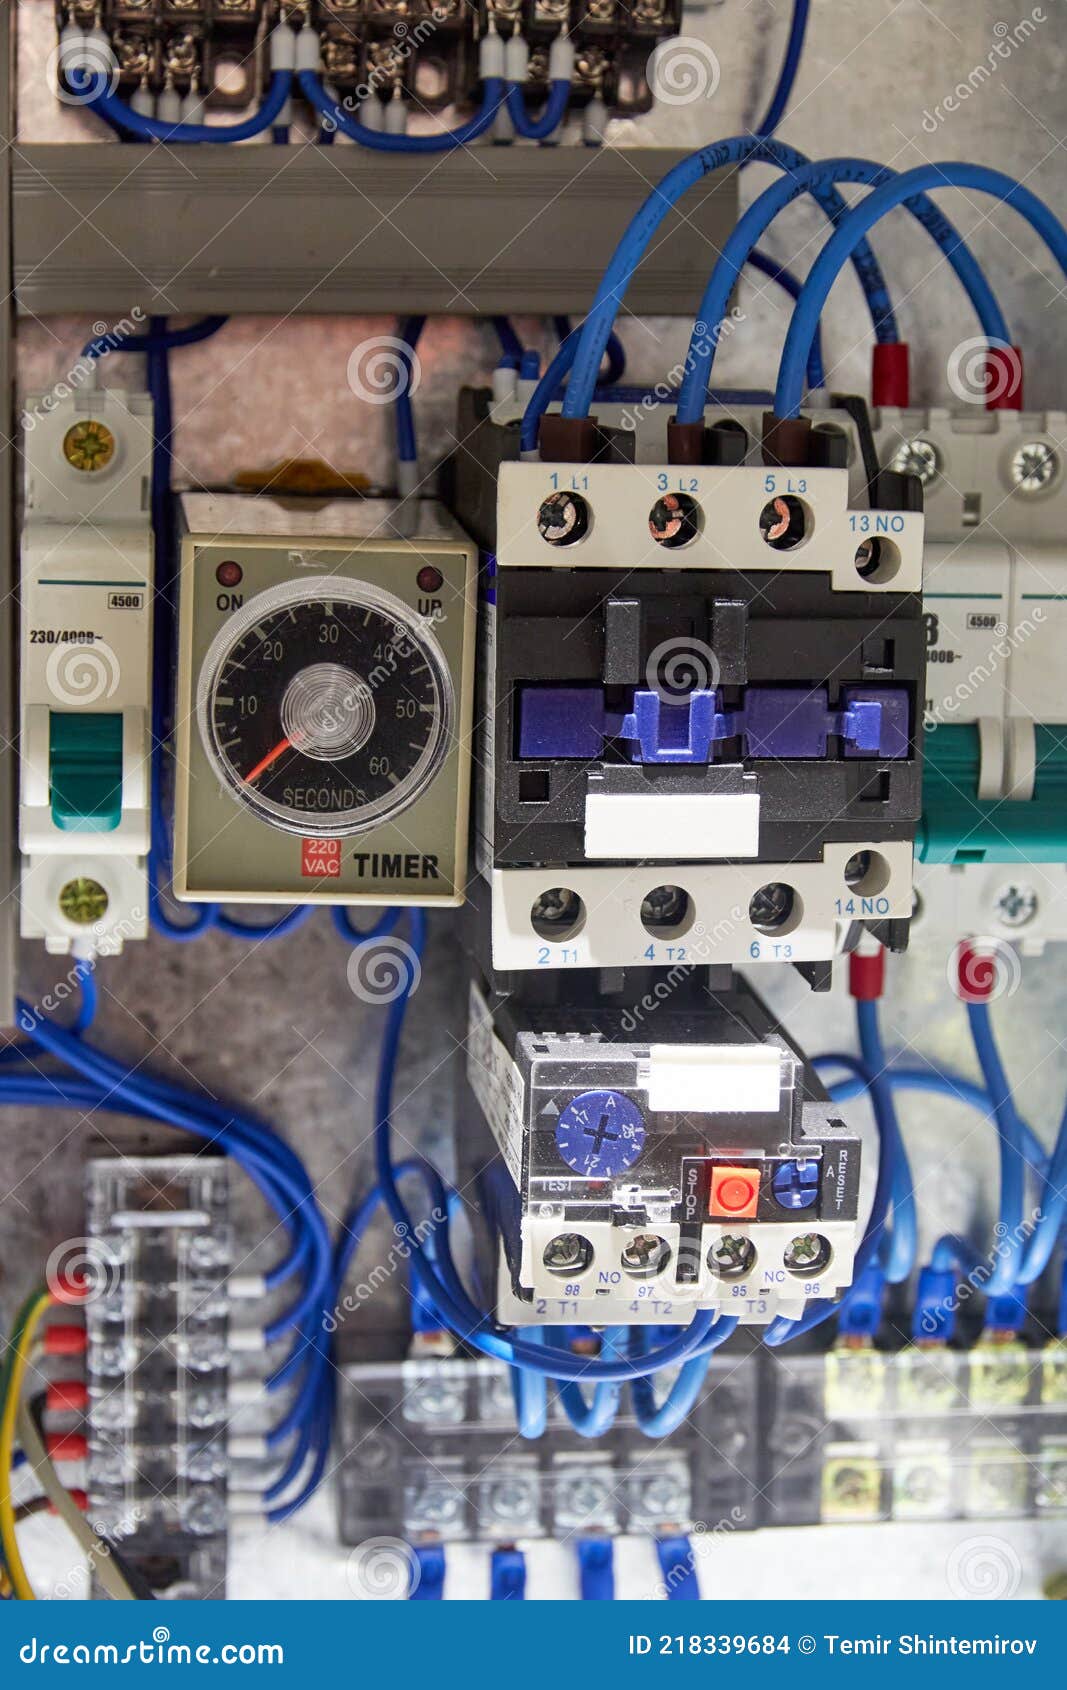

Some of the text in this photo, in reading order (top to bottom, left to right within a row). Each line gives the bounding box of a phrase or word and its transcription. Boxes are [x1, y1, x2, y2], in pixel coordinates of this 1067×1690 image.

[549, 473, 589, 490] 1 L1
[657, 473, 699, 492] 3 L2
[764, 474, 808, 493] 5 L3
[849, 515, 905, 533] 13 NO
[111, 595, 140, 607] 4500
[216, 594, 243, 611] ON
[970, 616, 996, 627] 4500
[319, 624, 340, 643] 30
[263, 641, 283, 661] 20
[373, 644, 393, 662] 40
[239, 696, 258, 715] 10
[396, 700, 416, 718] 50
[369, 757, 389, 776] 60
[283, 788, 367, 809] SECONDS
[308, 840, 337, 854] 220
[304, 859, 340, 875] VAC
[354, 853, 439, 879] TIMER
[835, 898, 890, 916] 14 NO
[538, 947, 578, 964] 2 T1
[644, 944, 686, 961] 4 T2
[750, 941, 793, 959] 6 T3
[605, 1096, 616, 1108] A
[576, 1110, 589, 1125] 17
[622, 1123, 635, 1139] 25
[826, 1165, 835, 1178] A
[836, 1149, 848, 1211] RESET
[542, 1180, 572, 1192] TEST
[686, 1168, 698, 1220] STOP
[599, 1271, 621, 1284] NO
[764, 1270, 786, 1282] NC
[564, 1285, 580, 1296] 98
[638, 1286, 654, 1298] 97
[732, 1285, 747, 1297] 95
[536, 1300, 578, 1315] 2 T1
[629, 1300, 673, 1314] 4 T2
[746, 1300, 767, 1314] T3
